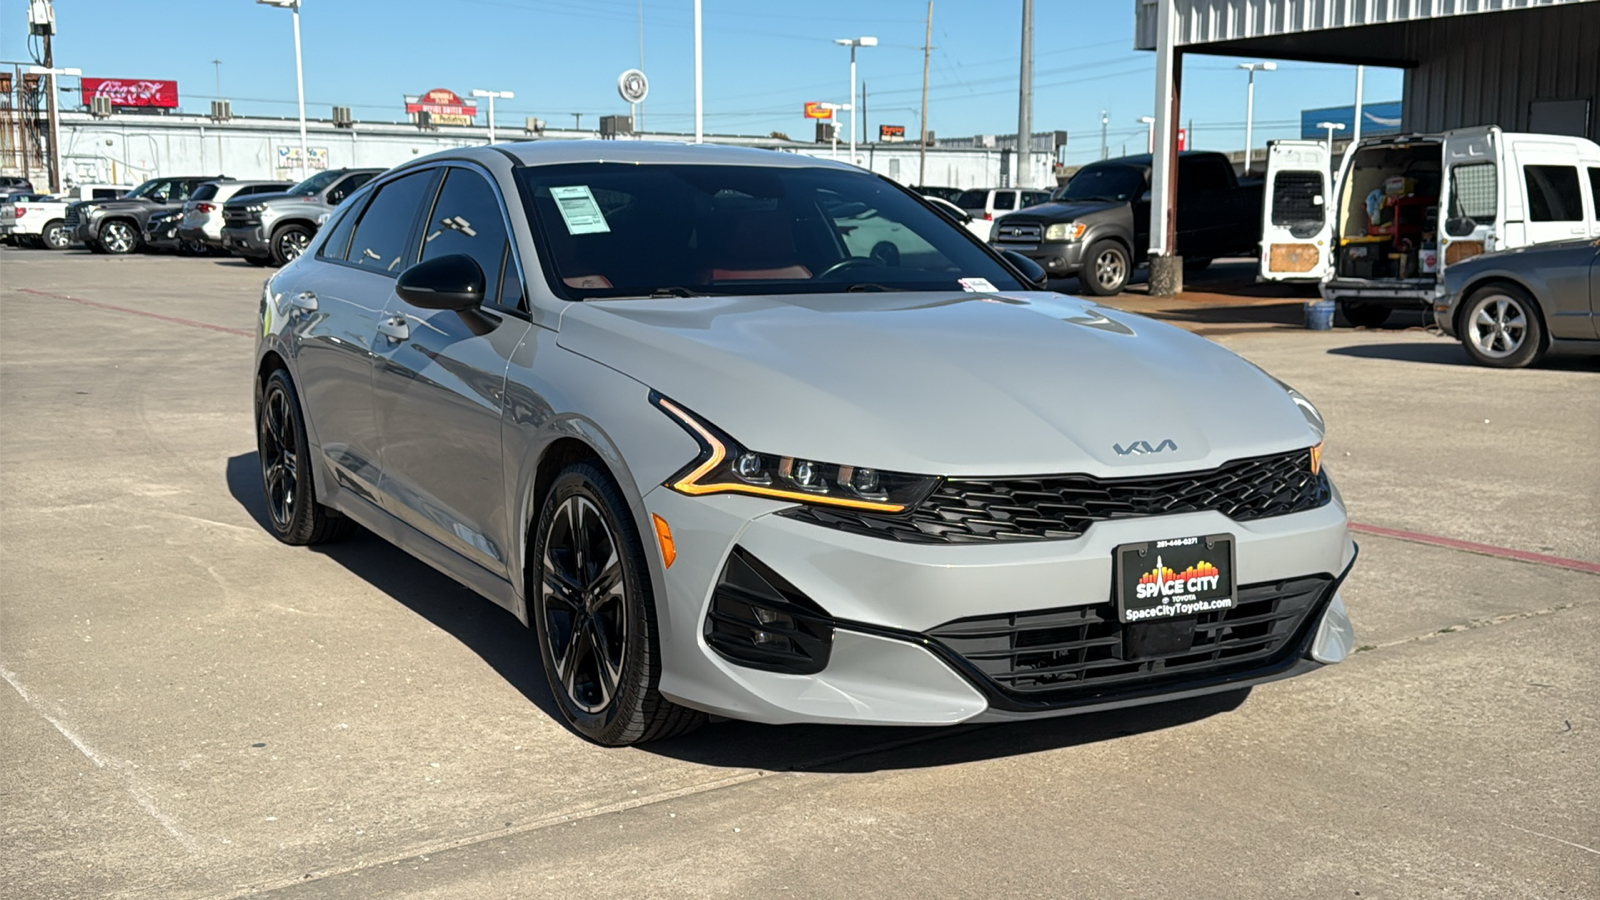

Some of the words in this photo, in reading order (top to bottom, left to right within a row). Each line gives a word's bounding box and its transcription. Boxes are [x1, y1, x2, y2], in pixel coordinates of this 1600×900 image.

[1112, 439, 1178, 457] KIA
[1136, 578, 1185, 599] SPACE
[1187, 575, 1219, 593] CITY
[1172, 594, 1196, 603] TOYOTA
[1126, 598, 1232, 621] SpaceCityToyota.com
